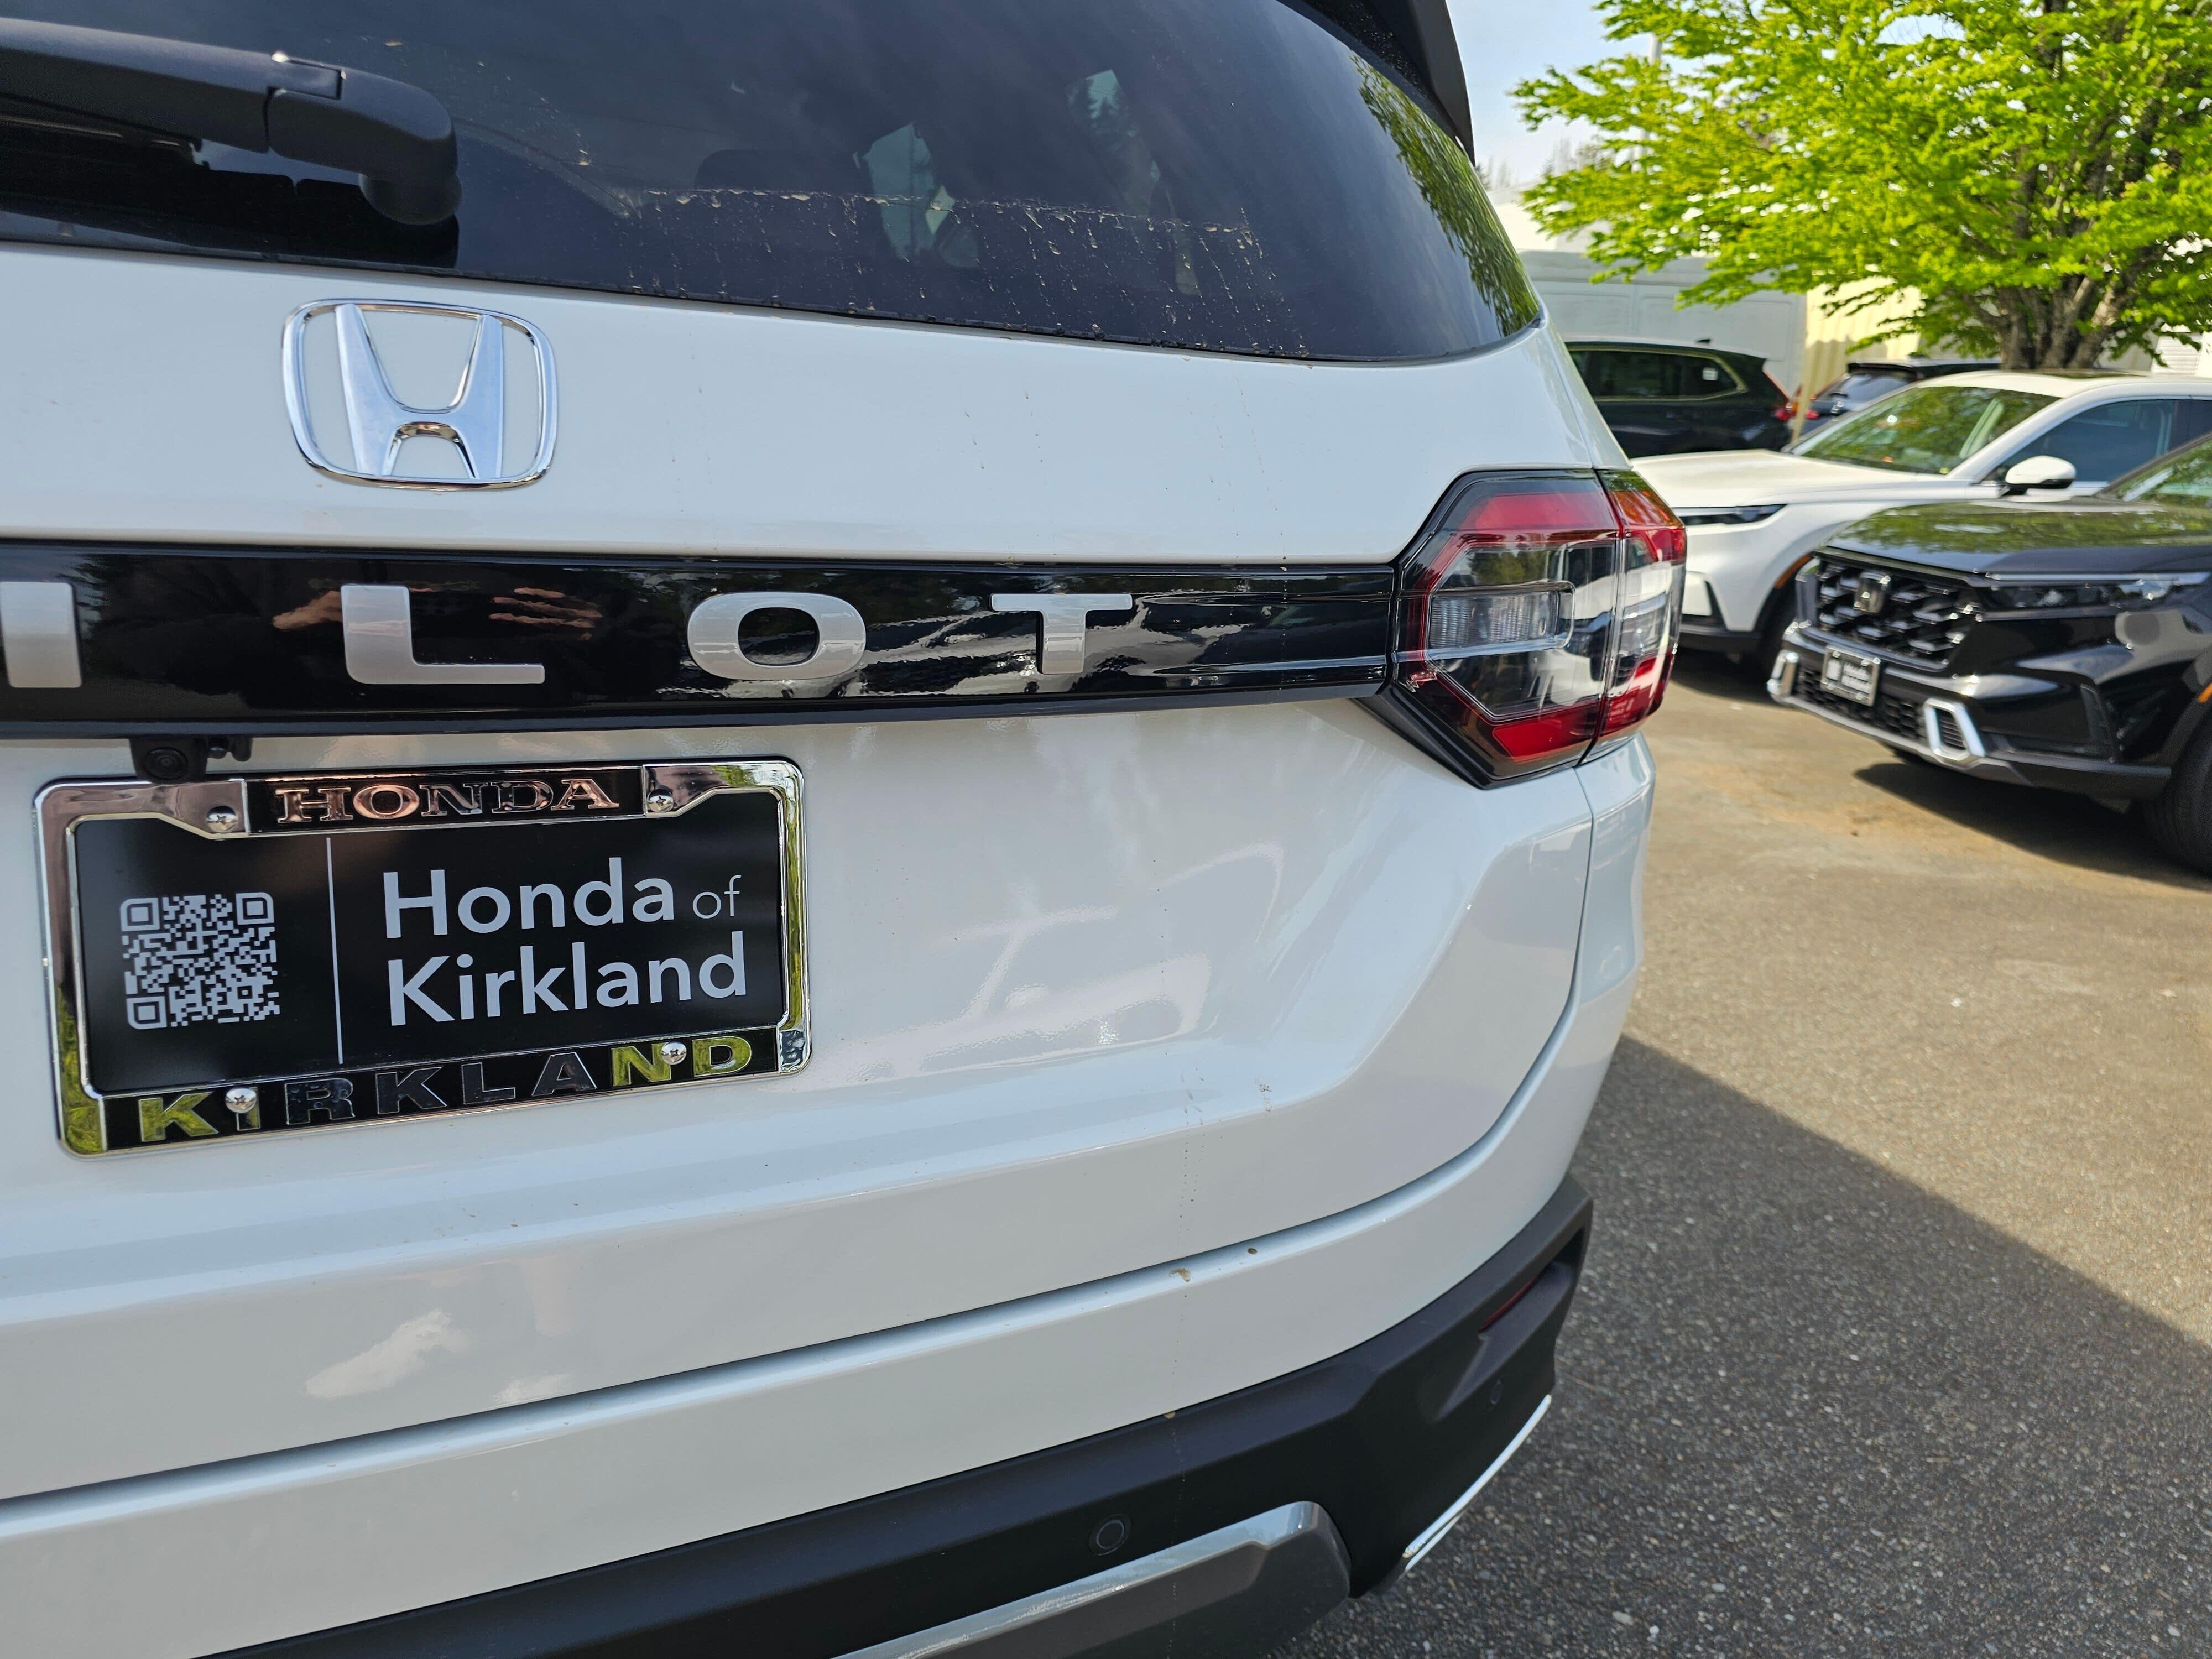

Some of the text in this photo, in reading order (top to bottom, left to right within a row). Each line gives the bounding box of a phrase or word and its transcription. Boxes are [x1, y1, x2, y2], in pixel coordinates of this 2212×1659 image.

[276, 778, 619, 823] HONDA
[382, 857, 742, 940] Honda of
[387, 932, 748, 1026] Kirkland
